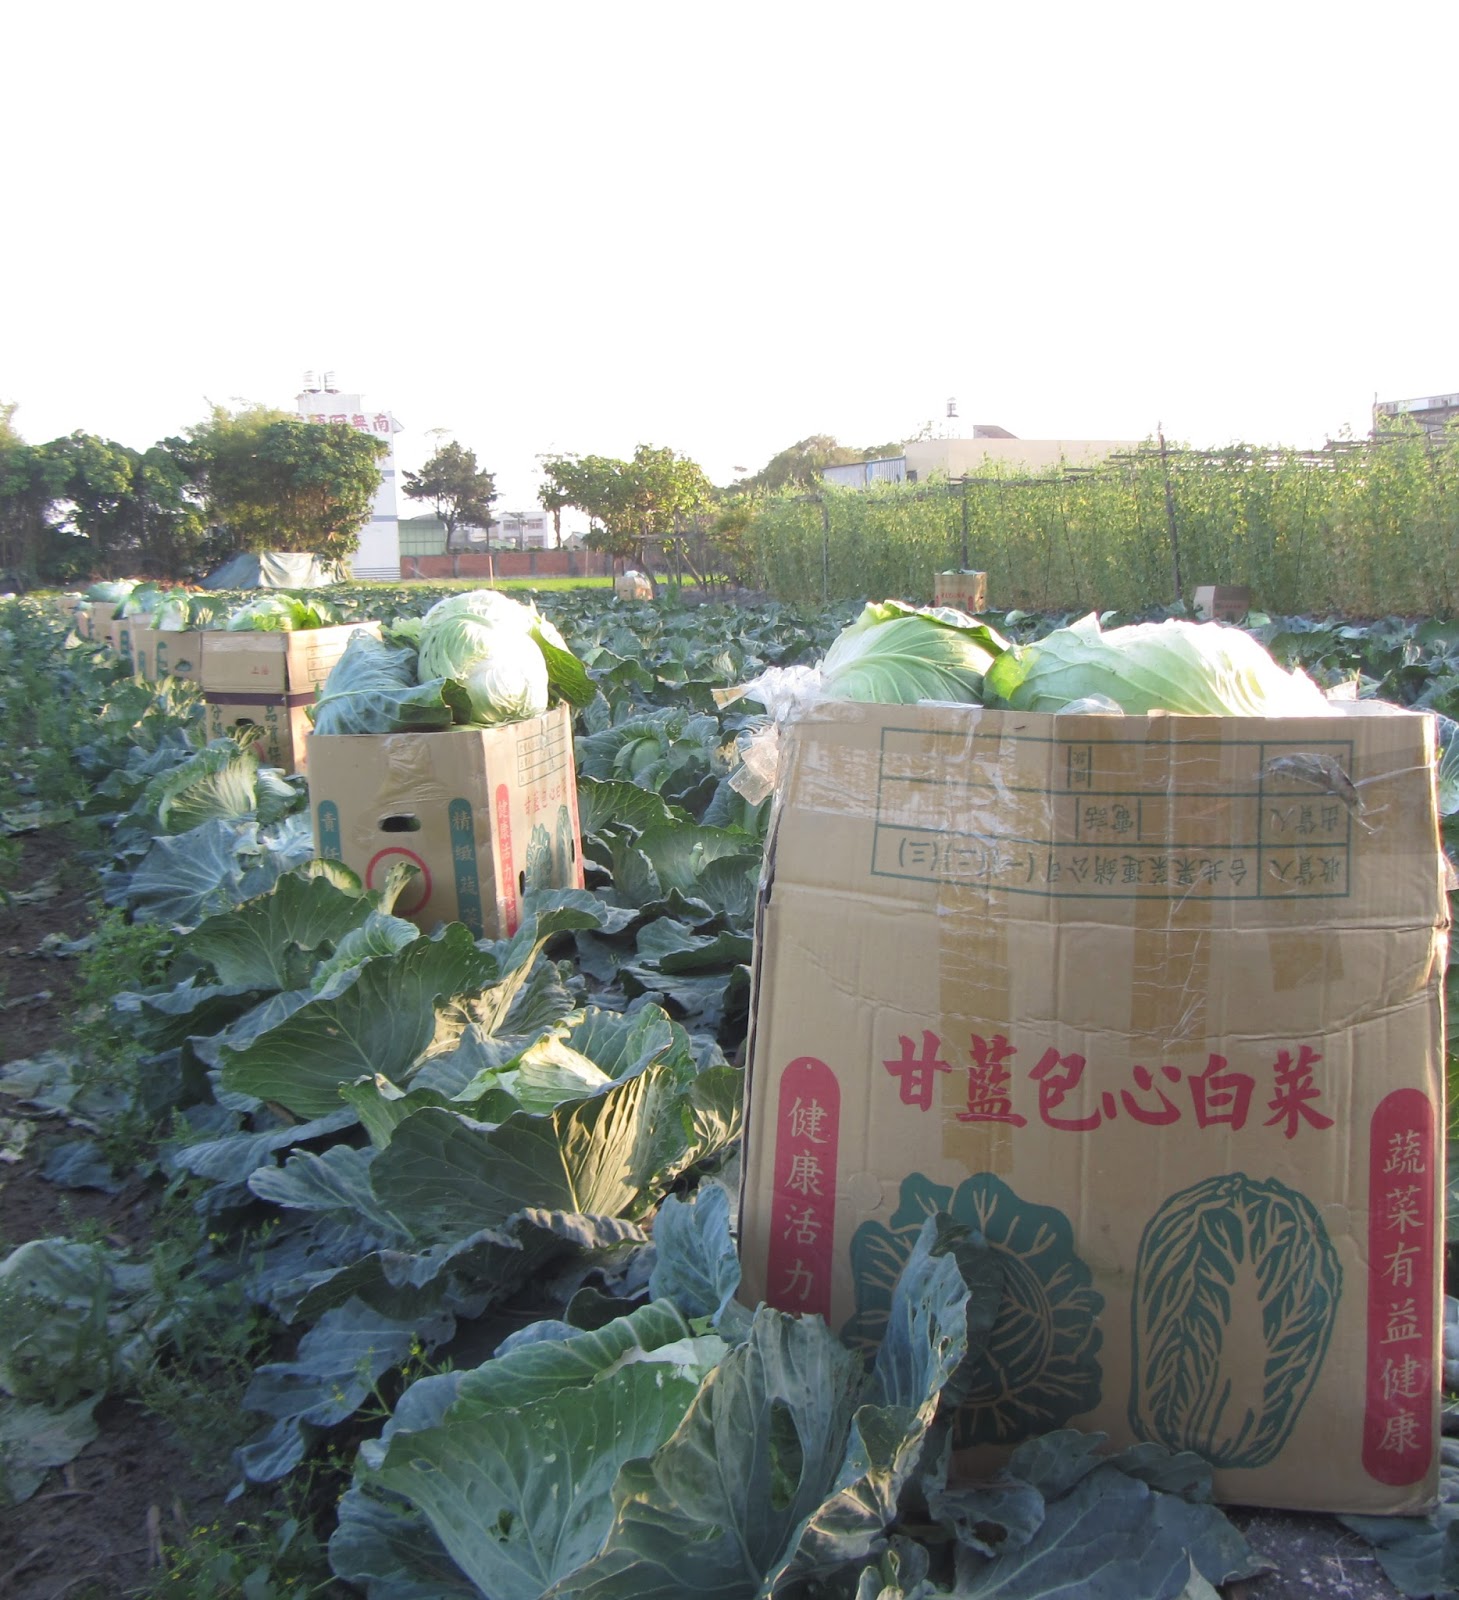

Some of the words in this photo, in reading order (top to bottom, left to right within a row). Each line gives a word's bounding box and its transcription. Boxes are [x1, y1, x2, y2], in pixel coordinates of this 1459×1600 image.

[1084, 804, 1134, 834] 電話
[1270, 804, 1341, 836] 出貨人
[1269, 855, 1341, 886] 收貨人
[884, 1030, 1335, 1140] 甘藍包心白菜
[782, 1095, 832, 1302] 健康活力
[1379, 1129, 1427, 1455] 蔬菜有益健康
